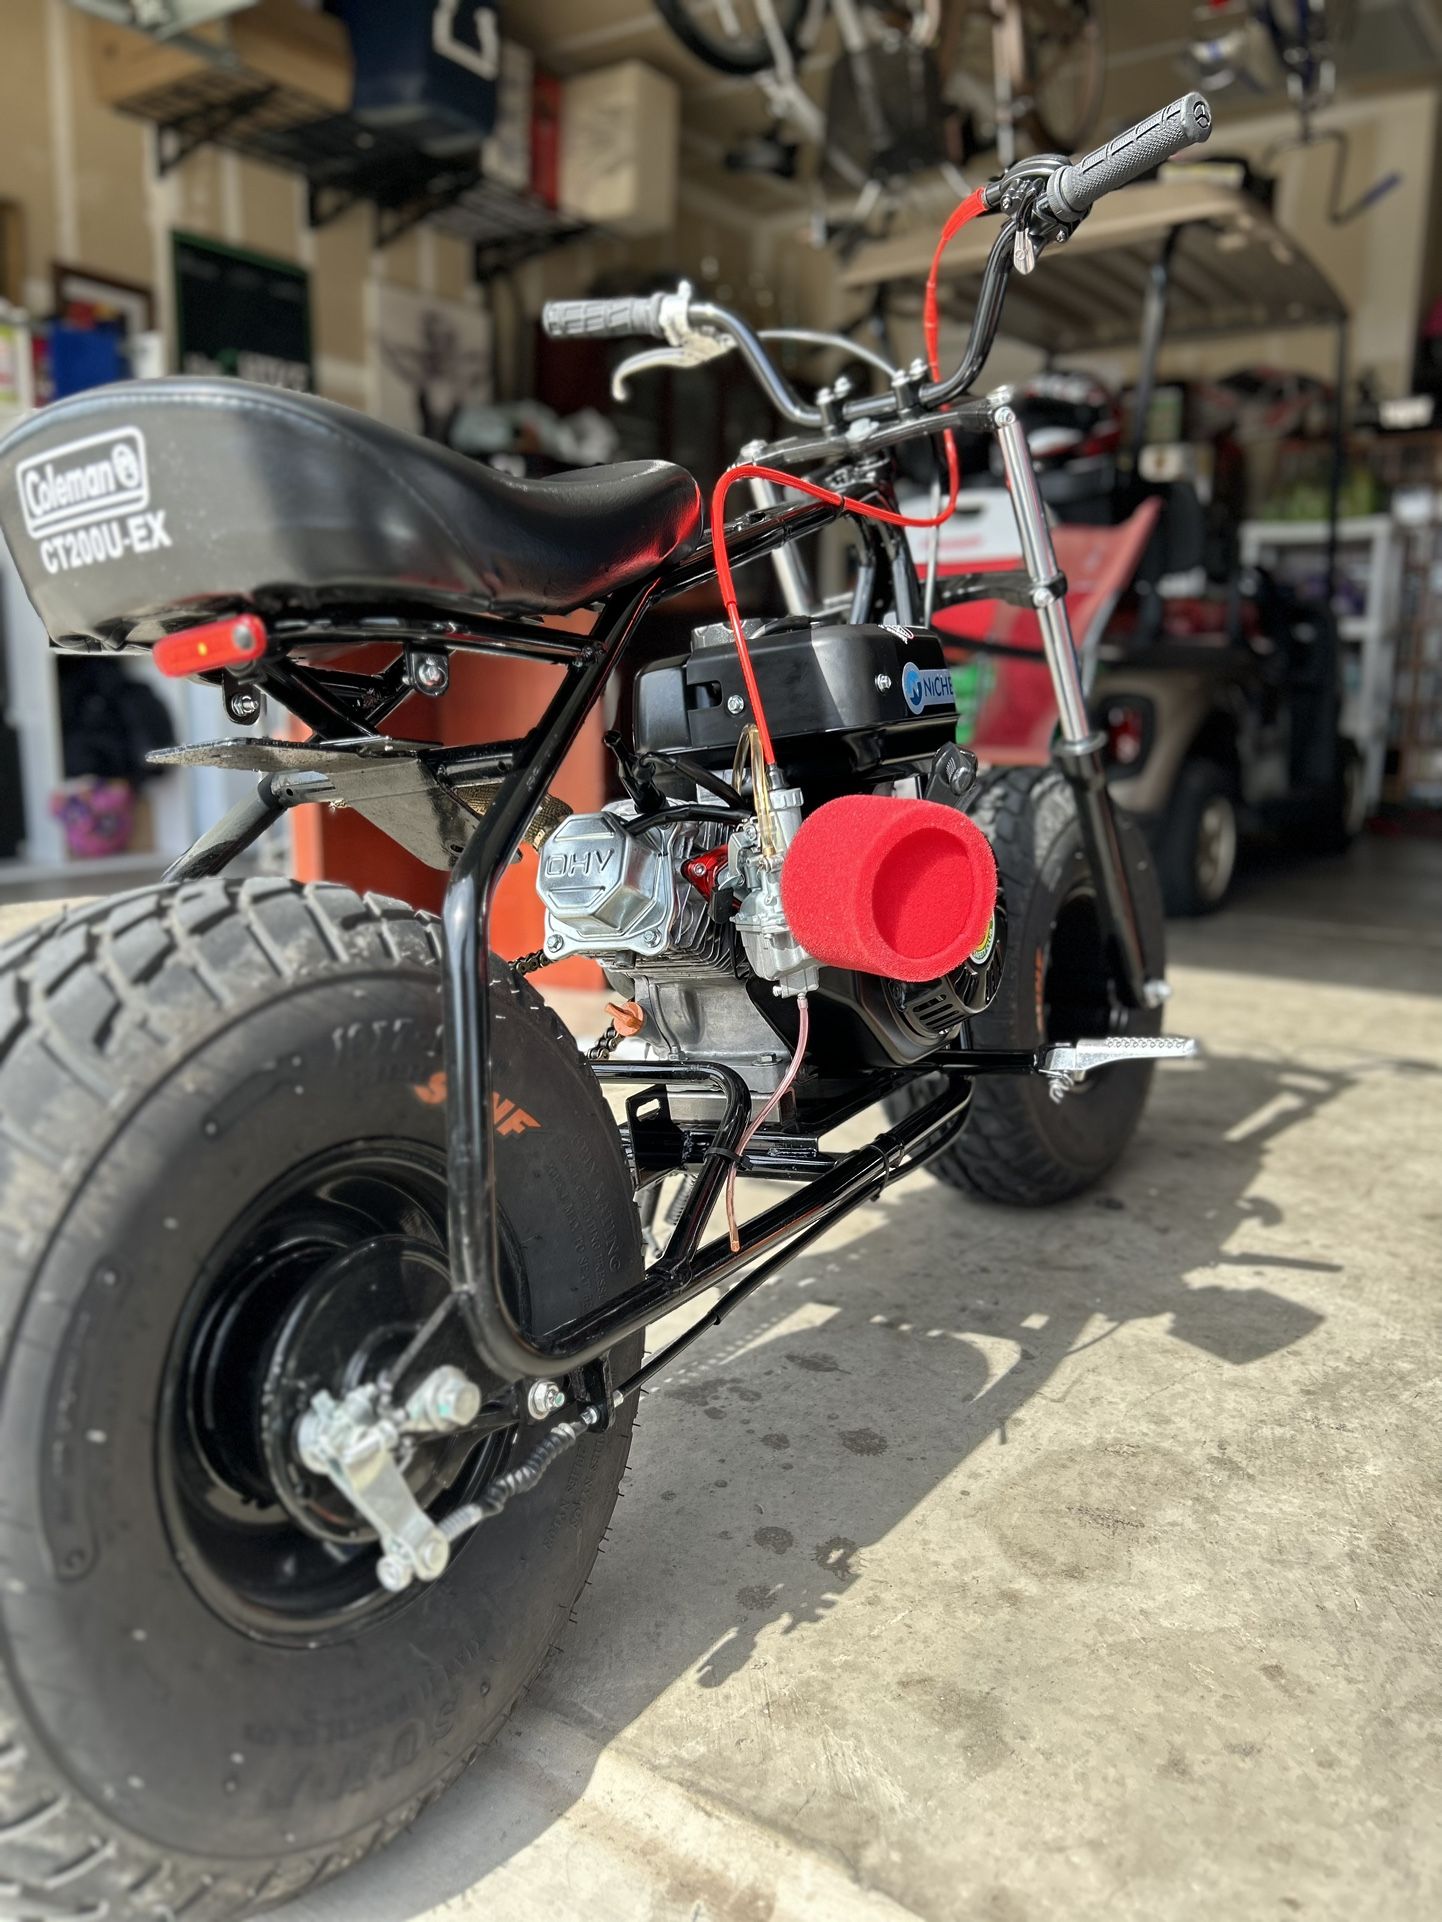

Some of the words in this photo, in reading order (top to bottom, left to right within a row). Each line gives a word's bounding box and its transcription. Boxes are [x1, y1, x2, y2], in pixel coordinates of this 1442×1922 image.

[25, 460, 117, 517] Coleman
[40, 509, 173, 574] CT200U-EX
[545, 848, 615, 878] OHV
